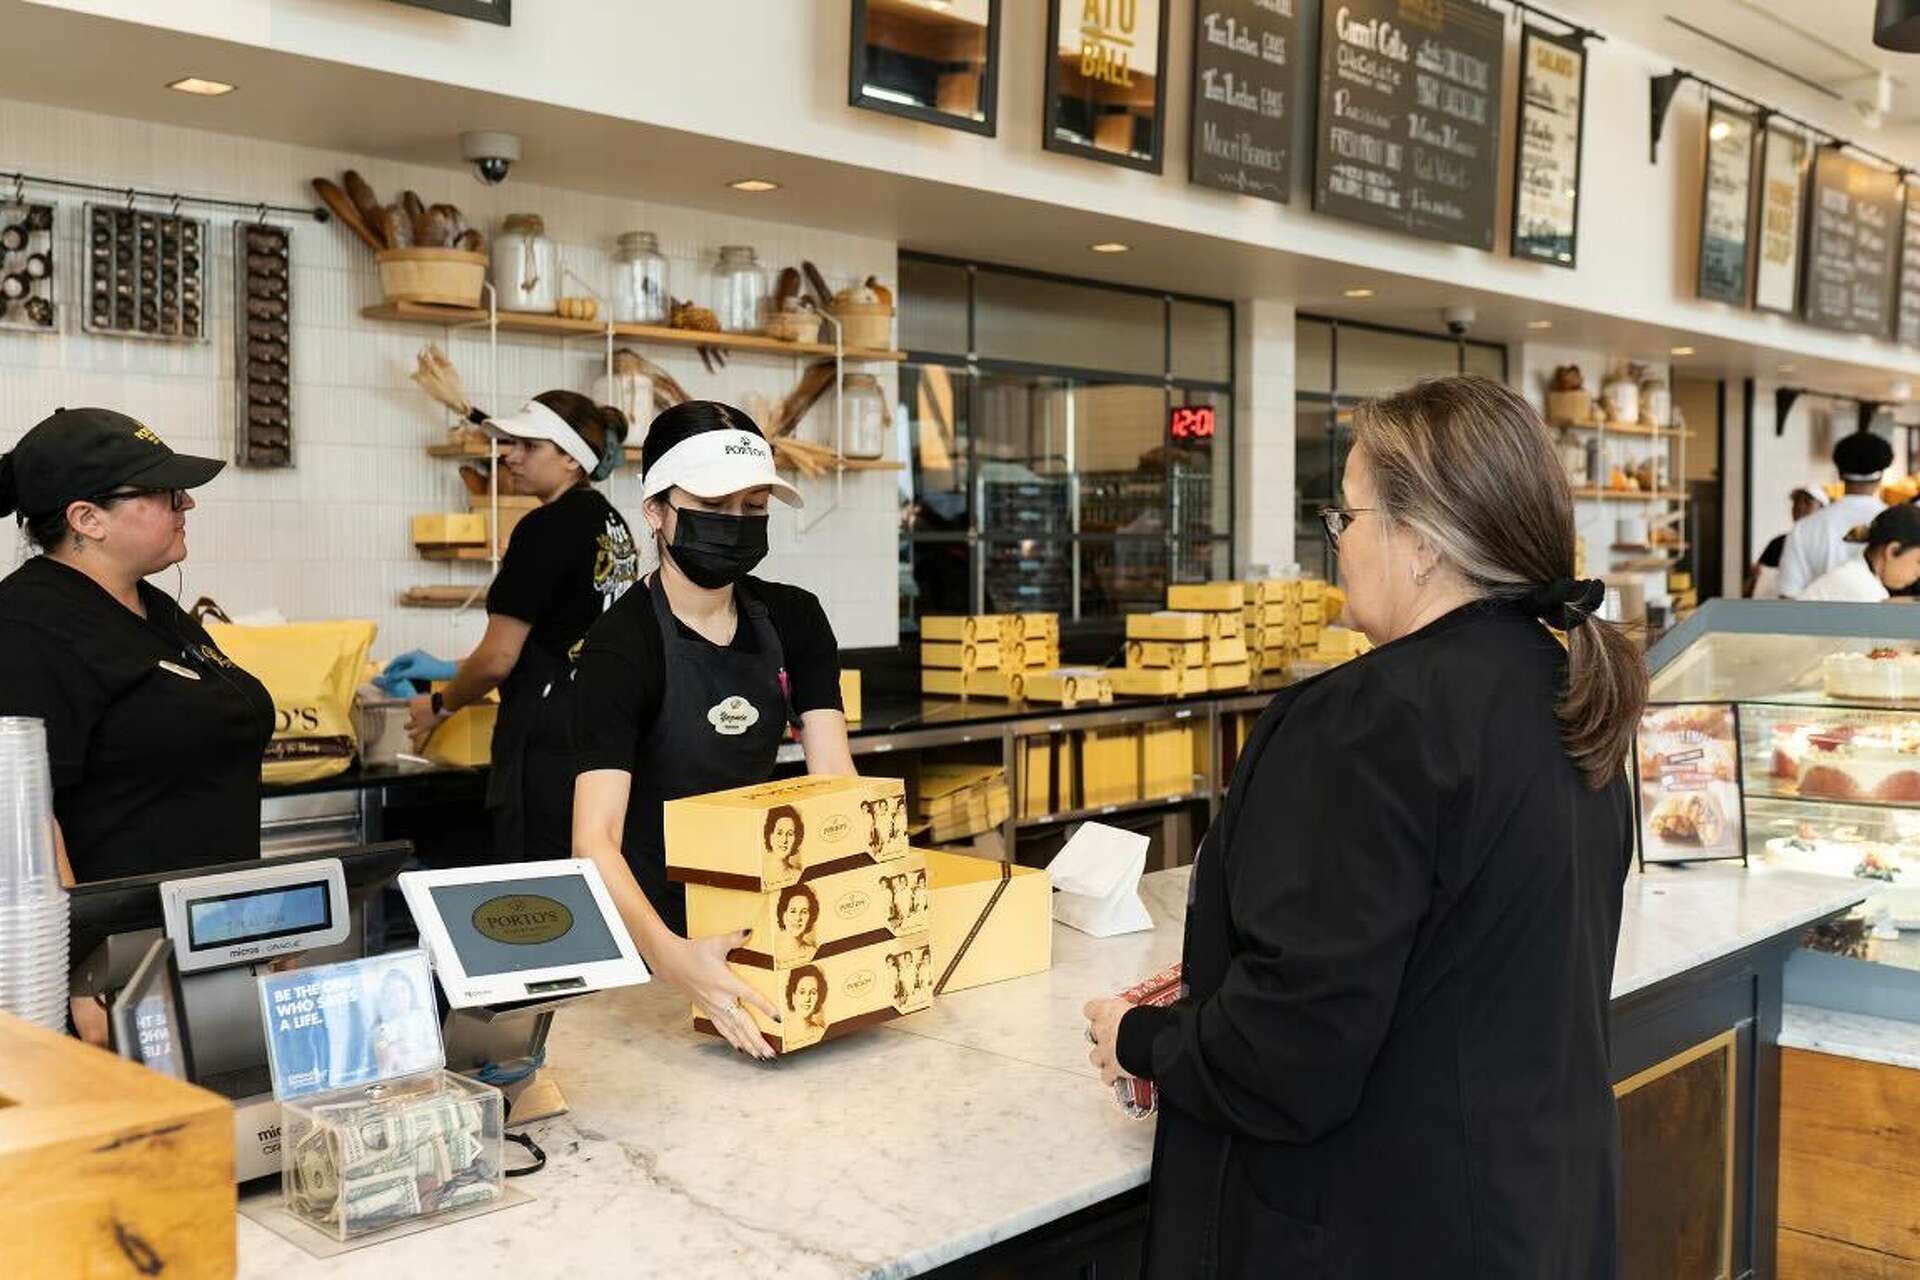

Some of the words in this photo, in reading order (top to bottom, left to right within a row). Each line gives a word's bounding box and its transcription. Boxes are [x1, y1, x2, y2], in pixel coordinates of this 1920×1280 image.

[1081, 40, 1134, 87] BALL
[487, 911, 558, 929] PORTO'S
[274, 988, 291, 1003] BE
[293, 983, 321, 999] THE
[275, 999, 313, 1018] WHO
[280, 1019, 291, 1033] A
